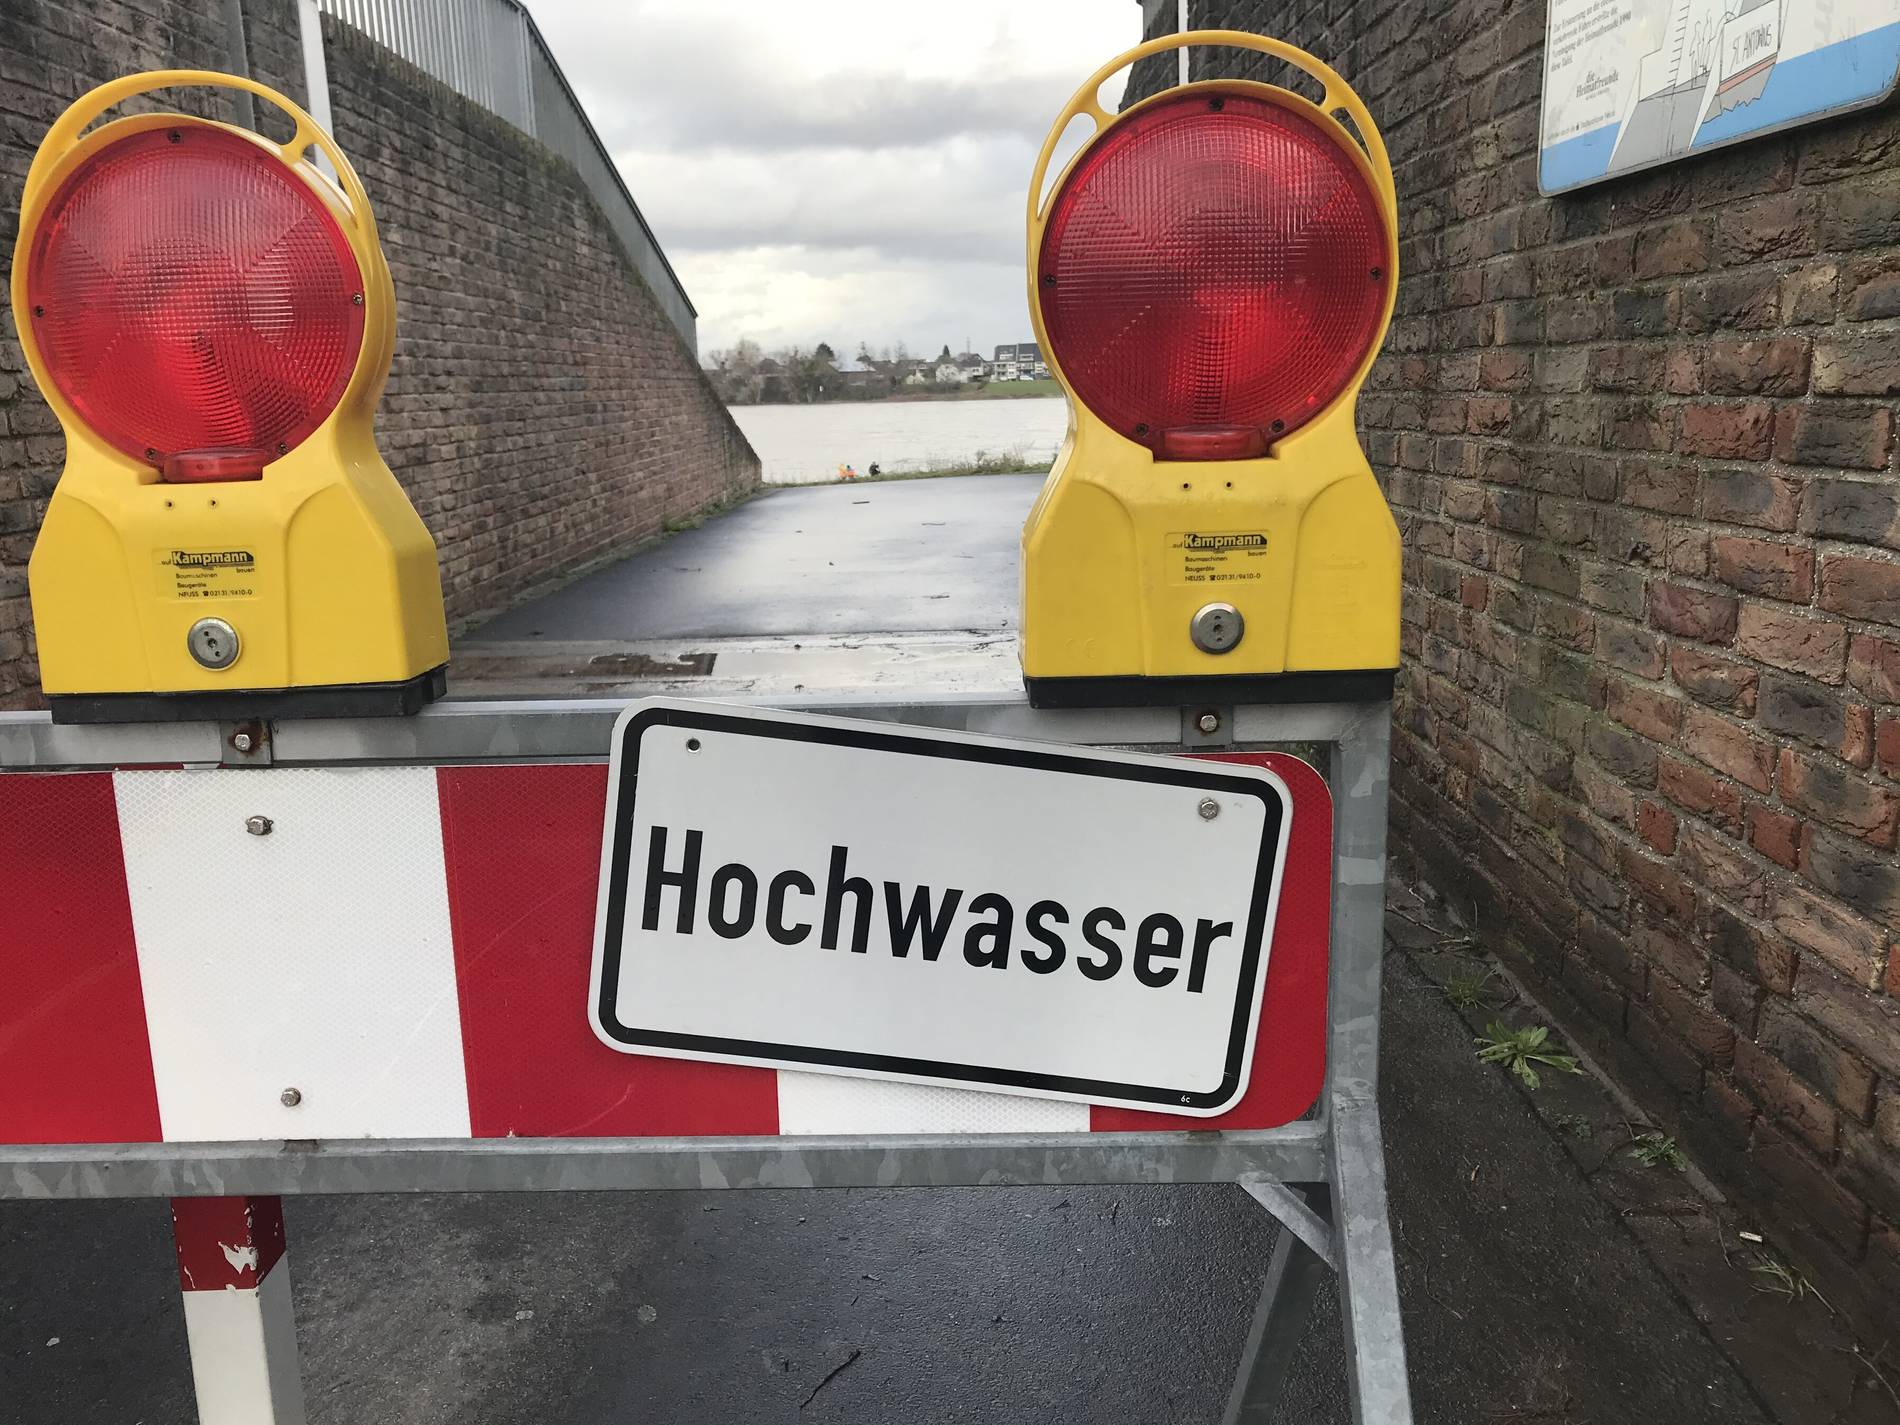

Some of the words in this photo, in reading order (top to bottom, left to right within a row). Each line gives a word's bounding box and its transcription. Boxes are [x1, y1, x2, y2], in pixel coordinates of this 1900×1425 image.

[1184, 534, 1262, 549] Kampmann
[172, 552, 248, 566] Kampmann
[641, 826, 1233, 993] Hochwasser
